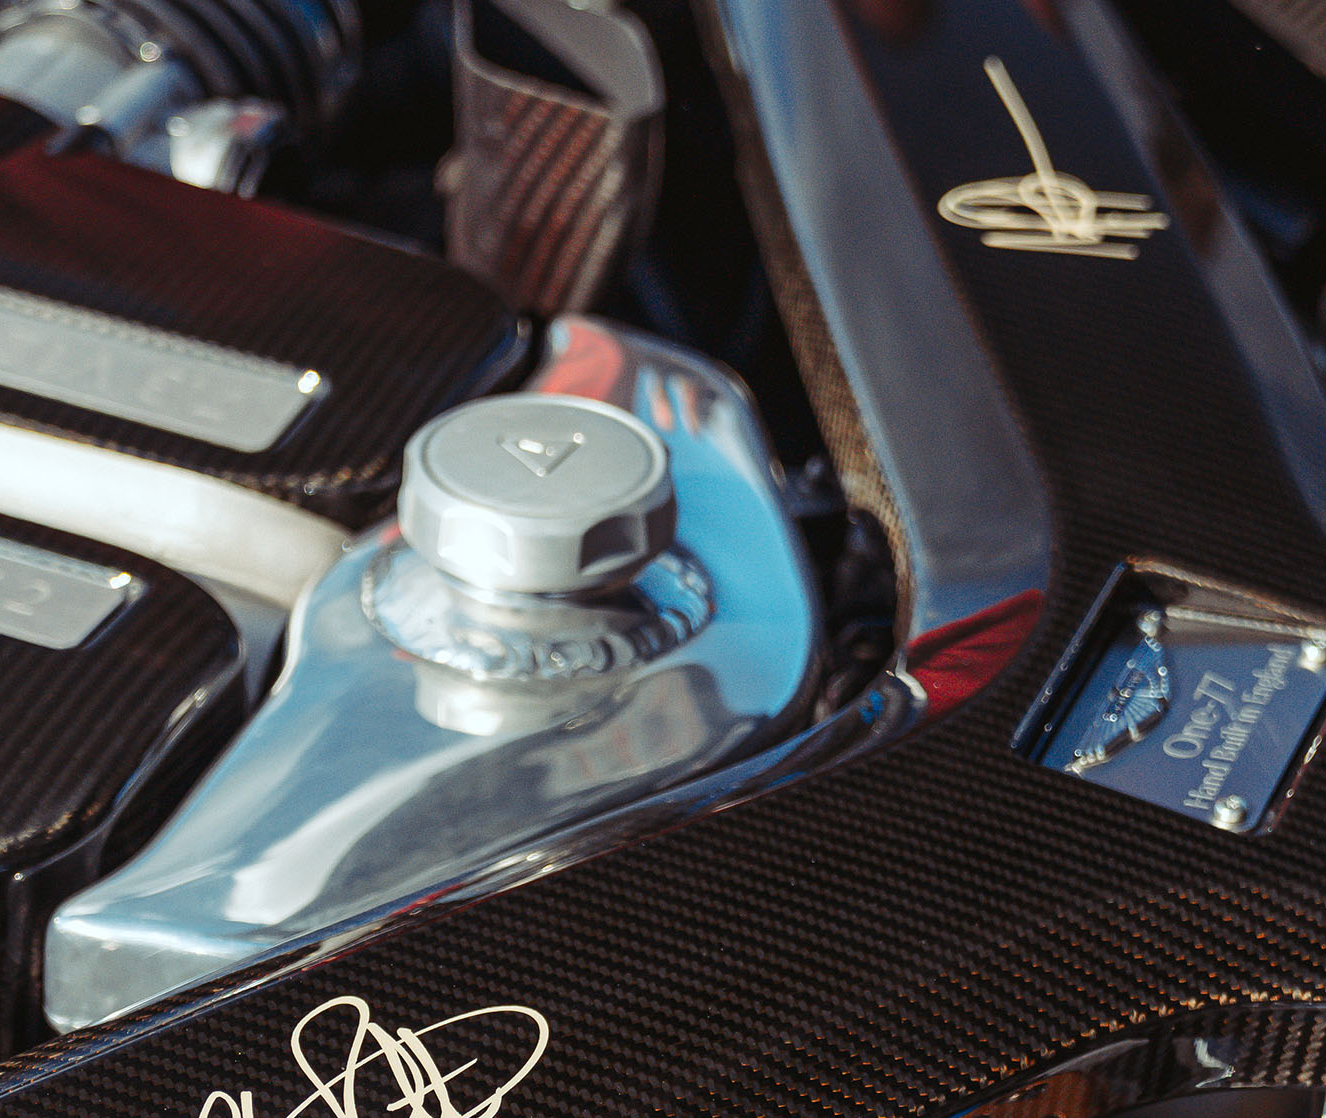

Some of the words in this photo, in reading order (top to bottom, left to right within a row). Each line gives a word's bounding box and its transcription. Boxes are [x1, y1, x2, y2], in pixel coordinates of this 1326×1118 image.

[1241, 643, 1296, 705] England
[1237, 705, 1263, 724] in
[1209, 722, 1252, 762] Built
[1183, 760, 1232, 810] Hand
